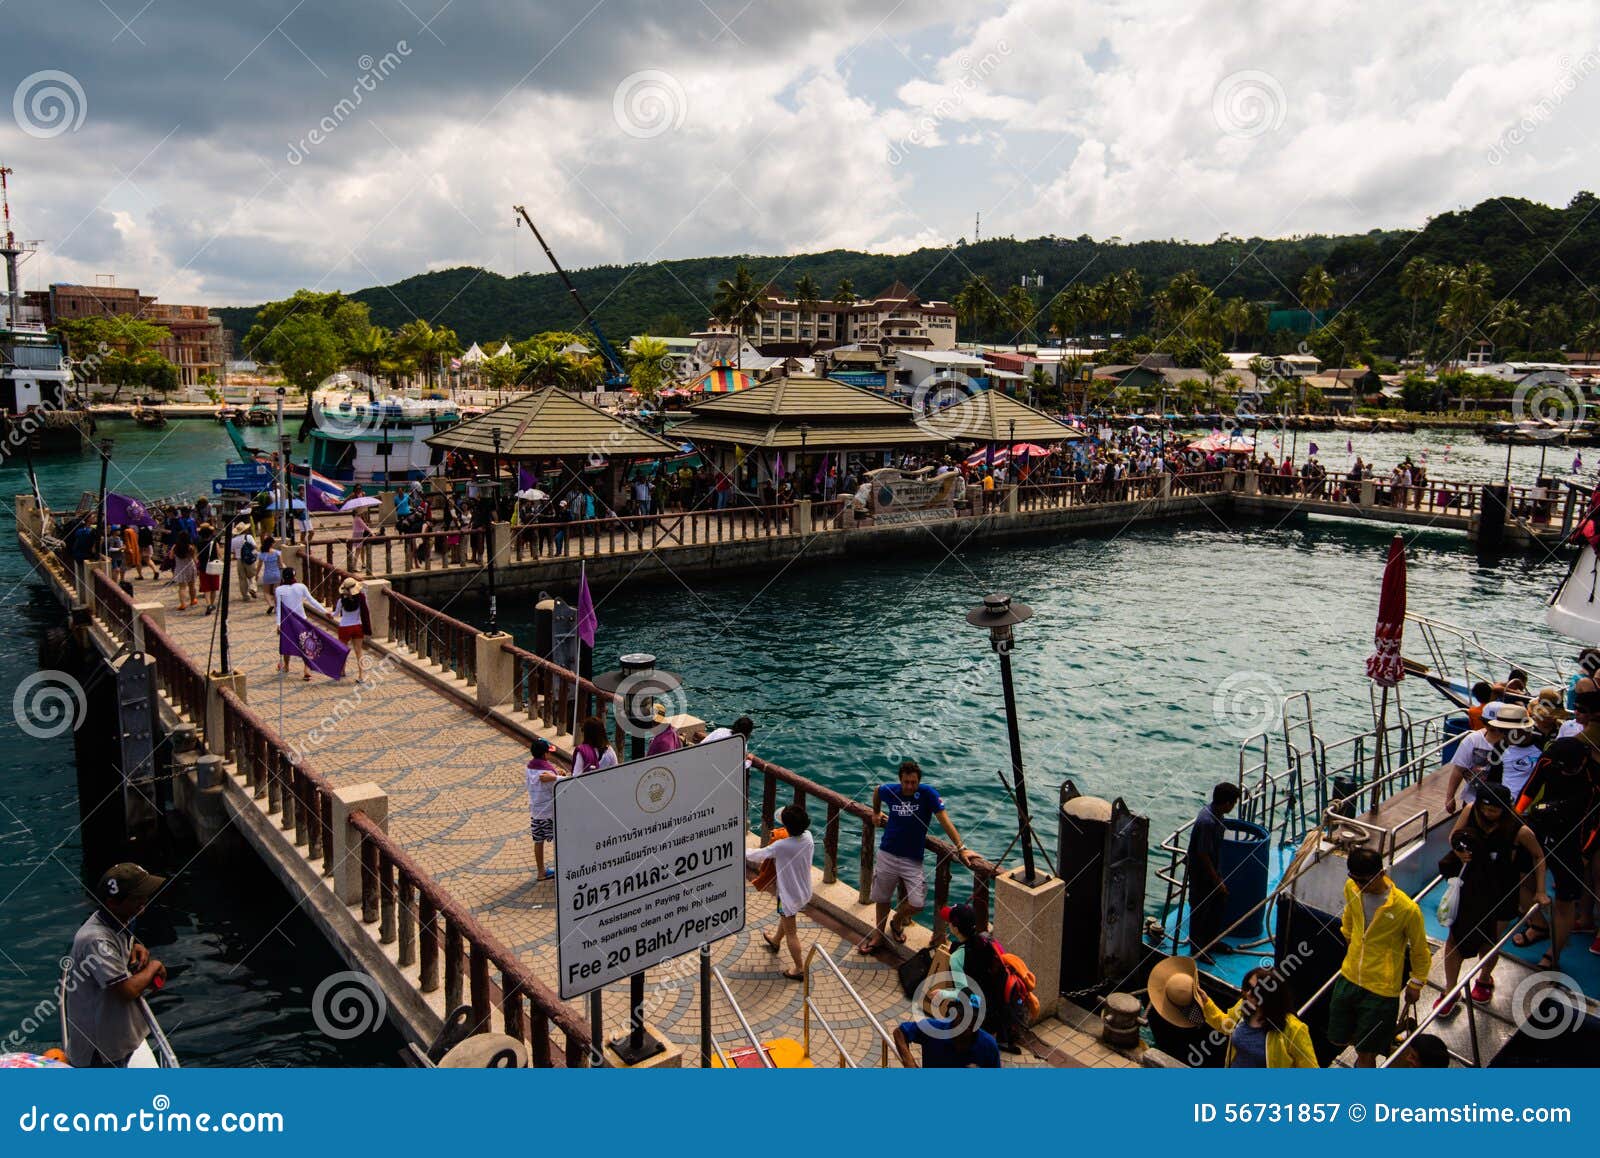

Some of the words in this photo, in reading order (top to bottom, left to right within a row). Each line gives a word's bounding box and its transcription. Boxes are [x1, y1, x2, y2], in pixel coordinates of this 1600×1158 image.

[107, 879, 119, 894] 3
[573, 864, 669, 910] อัตราคนละ
[675, 852, 698, 876] 20
[702, 841, 733, 865] บาท
[582, 938, 598, 949] The
[600, 924, 637, 943] sparkling
[640, 915, 661, 928] clean
[664, 911, 674, 920] on
[677, 904, 689, 915] Phi
[691, 900, 703, 909] Phi
[705, 890, 727, 904] Island
[598, 907, 642, 927] Assistance
[645, 903, 652, 911] in
[655, 893, 680, 907] Paying
[569, 959, 602, 984] Fee
[607, 946, 631, 969] 20
[636, 906, 738, 958] Baht/Person
